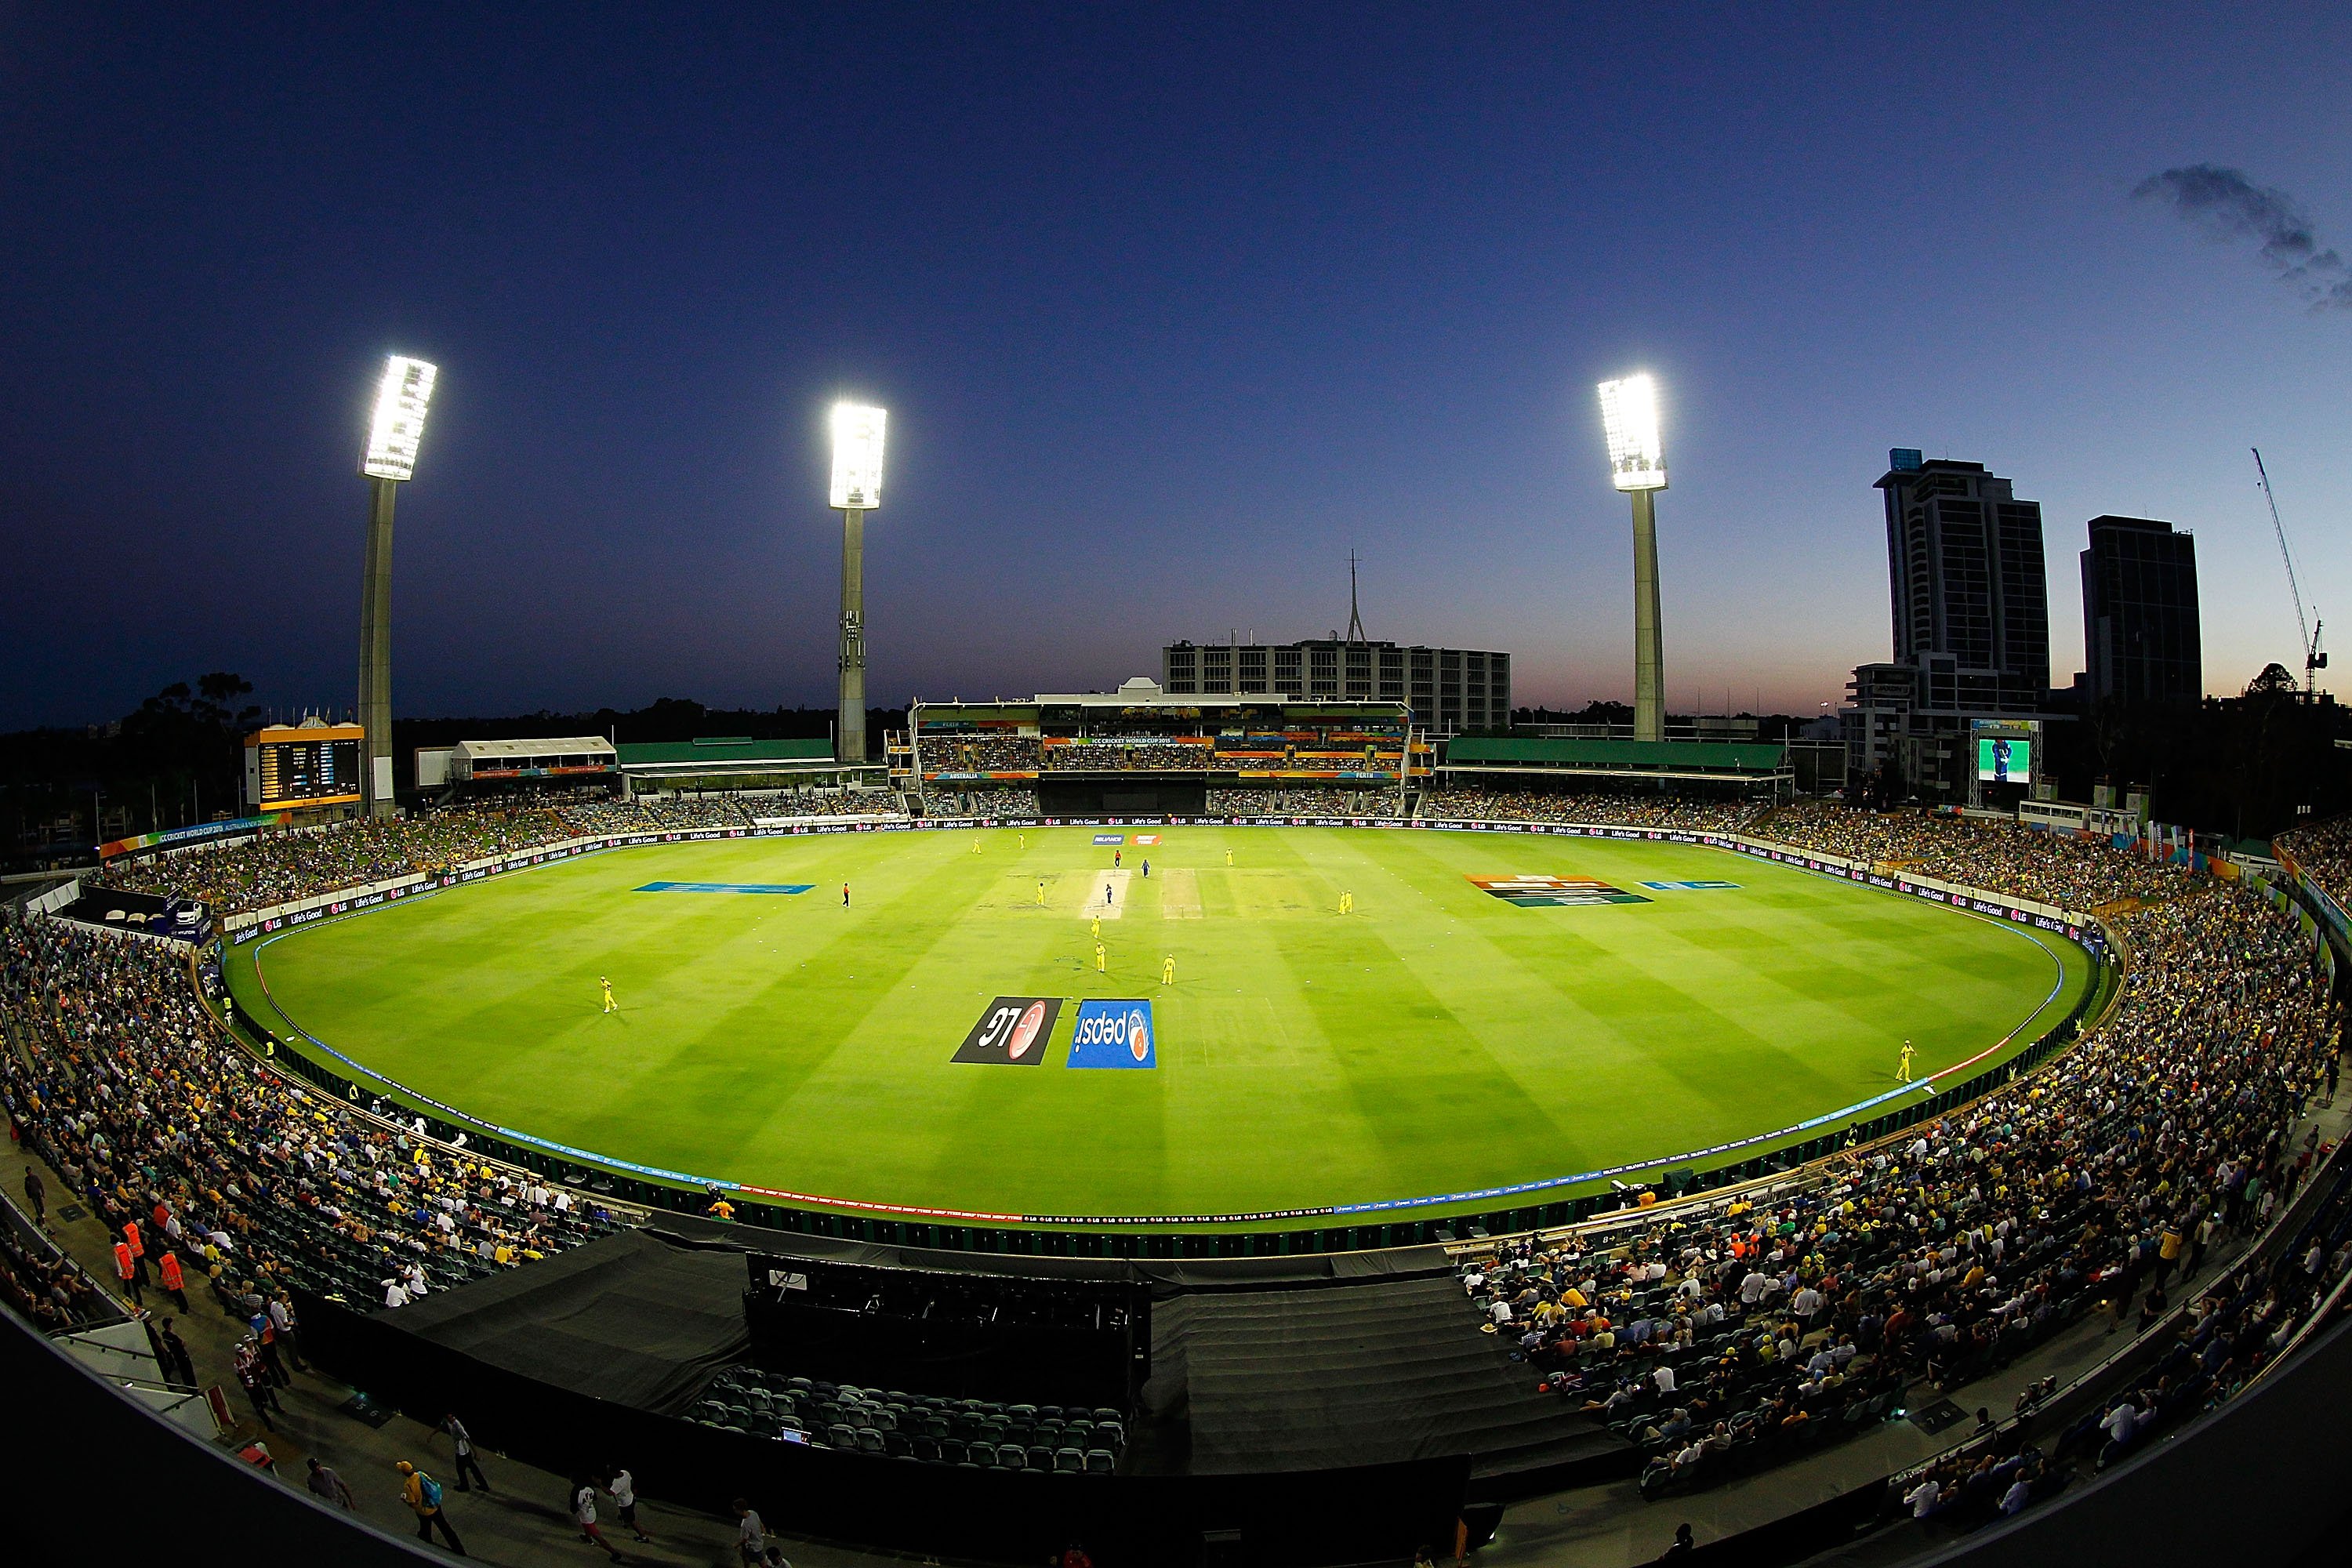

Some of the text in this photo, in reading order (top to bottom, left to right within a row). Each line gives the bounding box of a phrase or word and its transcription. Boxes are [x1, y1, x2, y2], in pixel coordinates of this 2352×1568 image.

[168, 832, 185, 841] CRICKET
[187, 829, 202, 838] WORLD
[203, 827, 212, 836] CUP
[473, 869, 485, 878] Good
[495, 864, 503, 873] LG
[448, 875, 456, 884] LG
[1880, 878, 1893, 888] Good
[424, 880, 437, 891] Good
[1904, 884, 1912, 893] LG
[397, 888, 405, 897] LG
[1930, 891, 1944, 902] Good
[369, 893, 383, 906] Good
[1958, 898, 1966, 906] LG
[338, 902, 347, 912] LG
[1987, 904, 2002, 916] Good
[307, 908, 322, 921] Good
[2017, 913, 2027, 922] LG
[272, 919, 282, 928] LG
[245, 927, 258, 941] Good
[978, 1007, 1022, 1047] LG
[1075, 1011, 1127, 1053] pepsi
